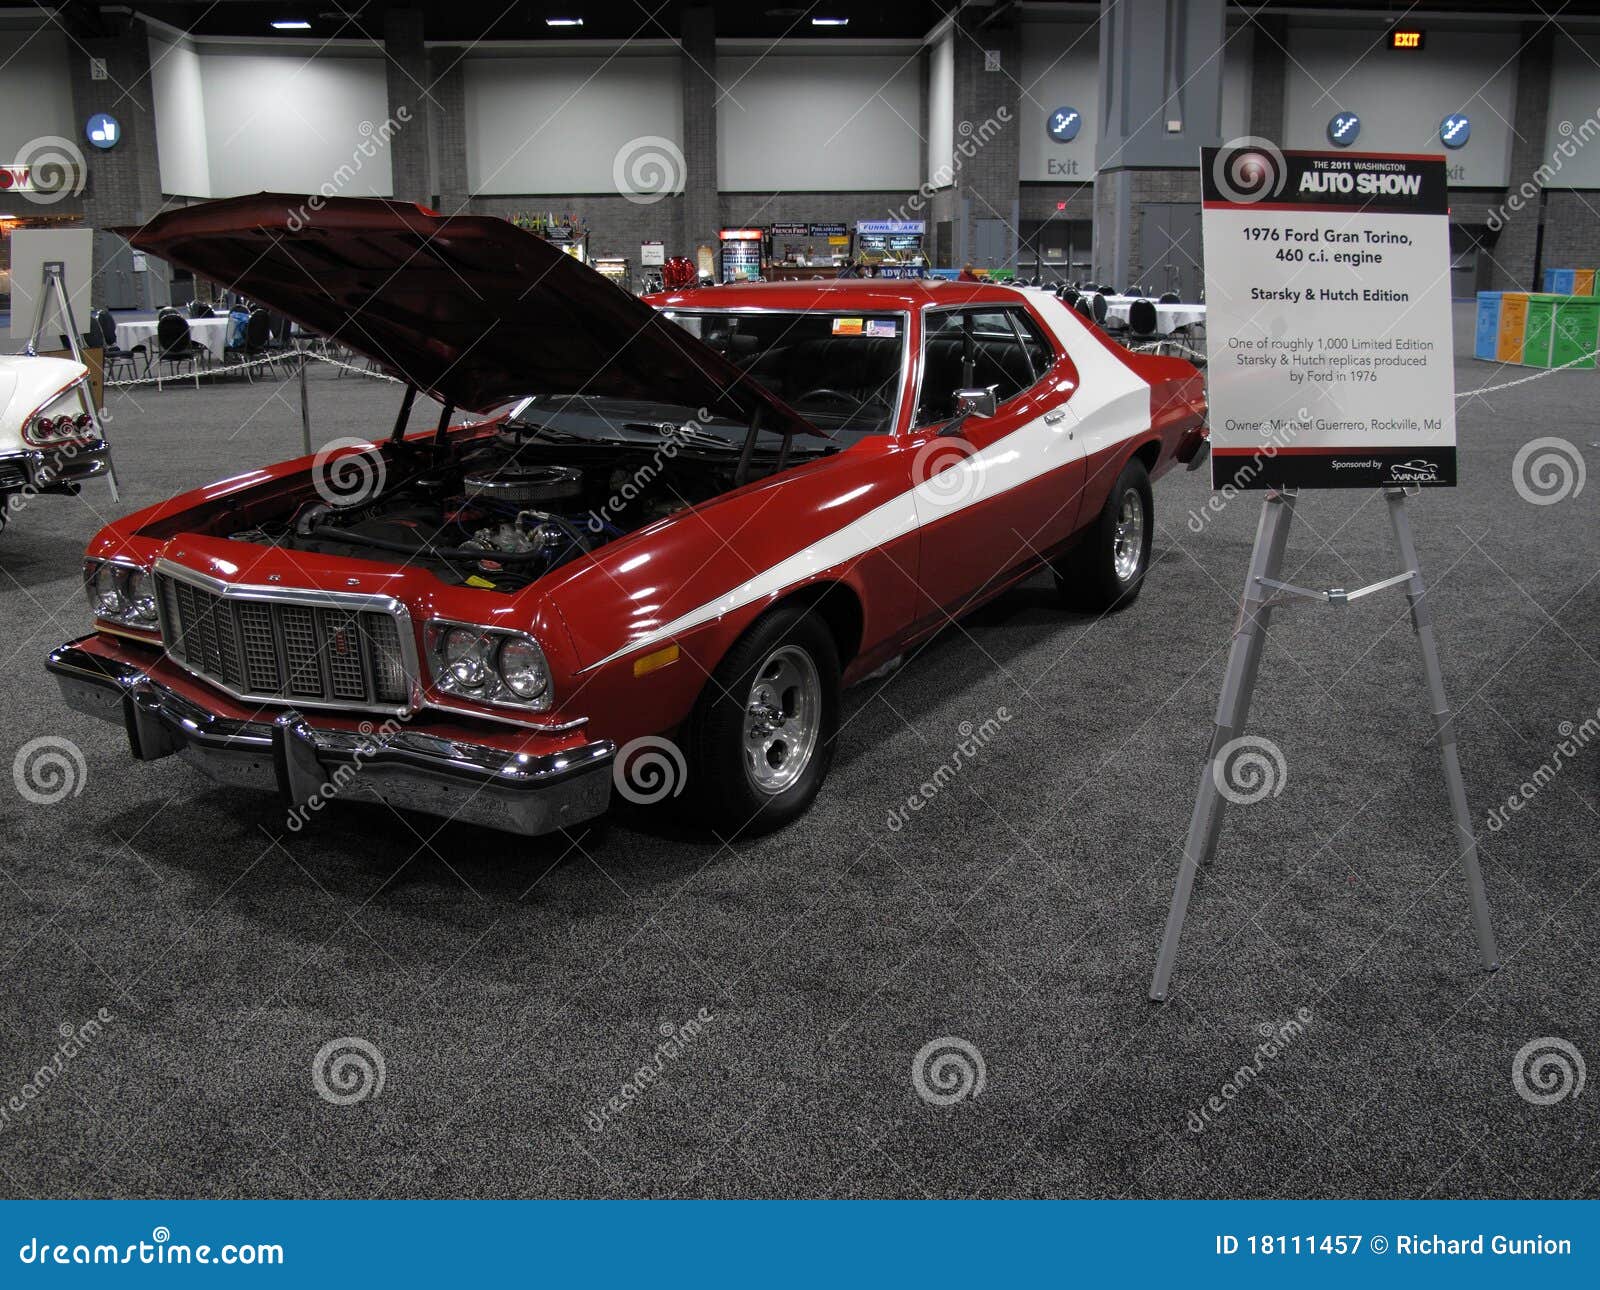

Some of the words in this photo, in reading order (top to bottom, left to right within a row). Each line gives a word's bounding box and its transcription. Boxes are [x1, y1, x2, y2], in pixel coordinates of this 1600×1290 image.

[1394, 33, 1420, 46] EXIT
[1047, 159, 1079, 175] Exit
[1313, 161, 1328, 169] THE
[1330, 161, 1351, 169] 2011
[1354, 162, 1406, 171] WASHINGTON
[1300, 172, 1354, 193] AUTO
[1356, 173, 1421, 195] SHOW
[1243, 228, 1280, 241] 1976
[1285, 228, 1319, 242] Ford
[1324, 229, 1359, 243] Gran
[1364, 230, 1413, 246] Torino,
[1275, 249, 1304, 262] 460
[1308, 250, 1329, 262] c.i.
[1334, 251, 1382, 266] engine
[1251, 288, 1300, 303] Starsky
[1305, 289, 1315, 300] &
[1320, 289, 1359, 301] Hutch
[1363, 290, 1409, 302] Edition
[1228, 337, 1253, 349] One
[1256, 337, 1269, 349] of
[1271, 338, 1314, 351] roughly
[1318, 338, 1348, 350] 1,000
[1351, 338, 1392, 350] Limited
[1395, 339, 1434, 350] Edition
[1236, 354, 1277, 368] Starsky
[1280, 354, 1289, 366] &
[1292, 354, 1326, 366] Hutch
[1329, 355, 1371, 368] replicas
[1374, 355, 1427, 368] produced
[1290, 371, 1304, 384] by
[1307, 371, 1333, 382] Ford
[1336, 371, 1346, 382] in
[1351, 371, 1377, 382] 1976
[1316, 419, 1367, 432] Guerrero,
[1371, 419, 1421, 432] Rockville,
[1424, 420, 1441, 430] Md
[1331, 460, 1372, 470] Sponsored
[1373, 460, 1382, 470] by
